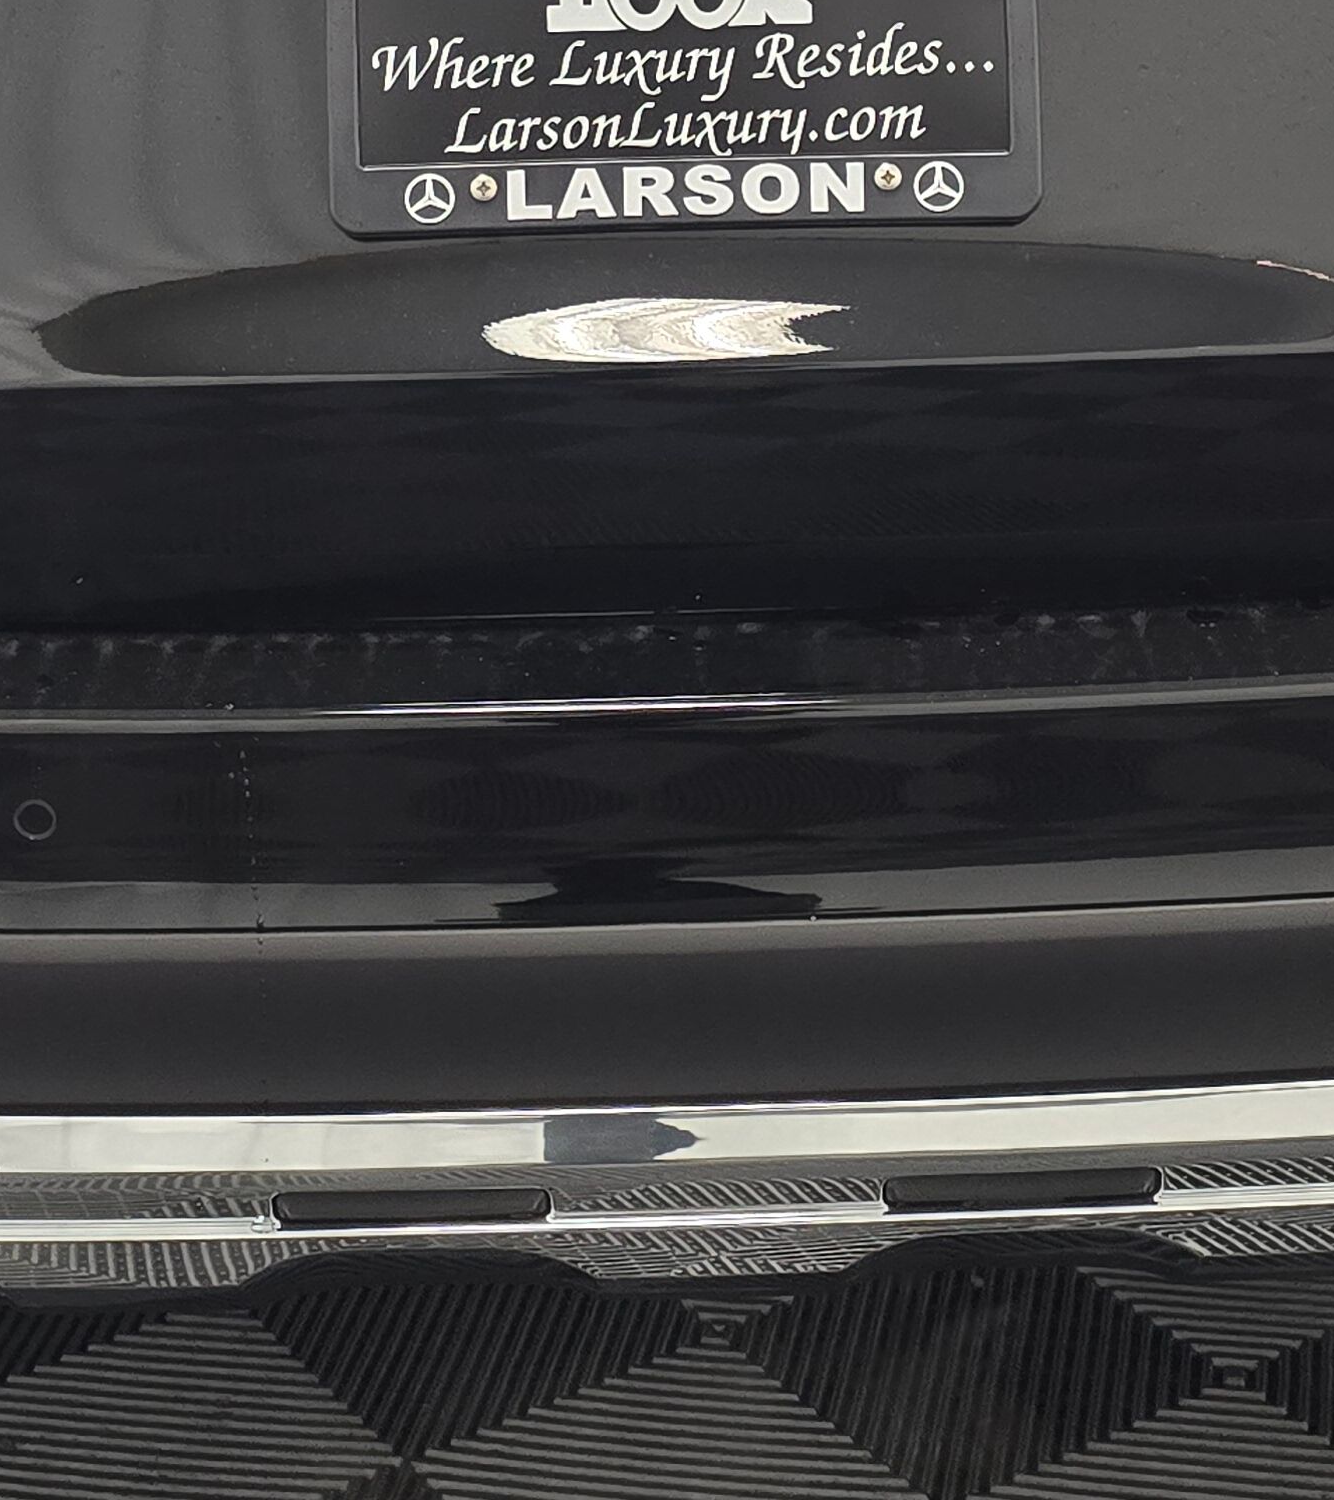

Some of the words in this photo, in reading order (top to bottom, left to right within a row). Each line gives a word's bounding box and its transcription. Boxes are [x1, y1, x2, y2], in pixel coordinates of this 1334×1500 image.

[370, 37, 535, 92] Where
[549, 40, 735, 100] Luxury
[753, 22, 995, 88] Resides...
[444, 103, 927, 155] LarsonLuxury.com
[506, 162, 865, 220] LARSON
